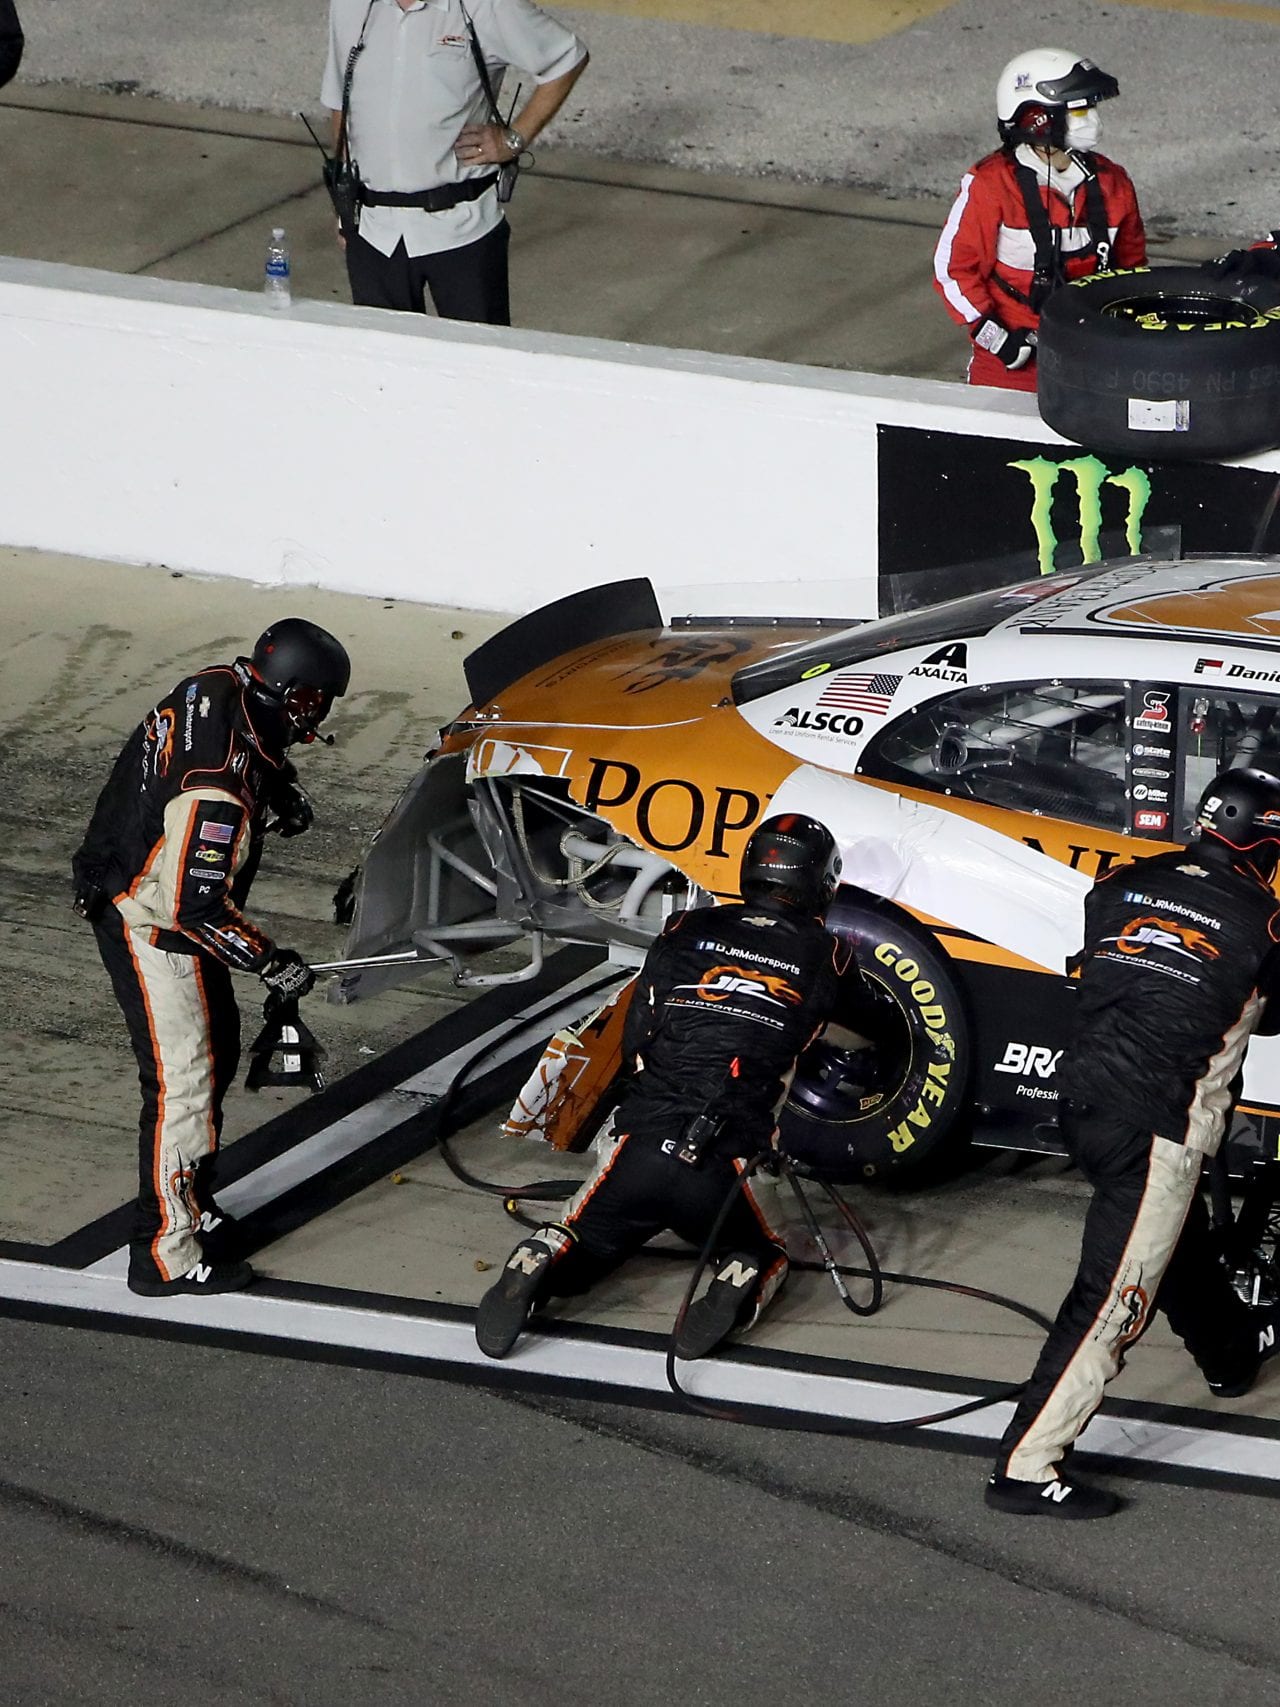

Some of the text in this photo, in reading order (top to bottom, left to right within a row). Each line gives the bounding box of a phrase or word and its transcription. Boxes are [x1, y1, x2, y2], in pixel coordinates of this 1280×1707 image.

[908, 665, 969, 685] AXALTA
[773, 707, 864, 736] ALSCO
[584, 757, 774, 859] POP
[1203, 796, 1223, 813] 9
[1138, 814, 1162, 827] SEM
[1151, 899, 1222, 931] JRMotorsports
[725, 946, 801, 976] JRMotorsports
[874, 942, 956, 1153] GOODYEAR
[184, 1262, 213, 1283] N
[716, 1259, 759, 1288] N
[1258, 1324, 1276, 1353] N
[1040, 1480, 1073, 1503] N
